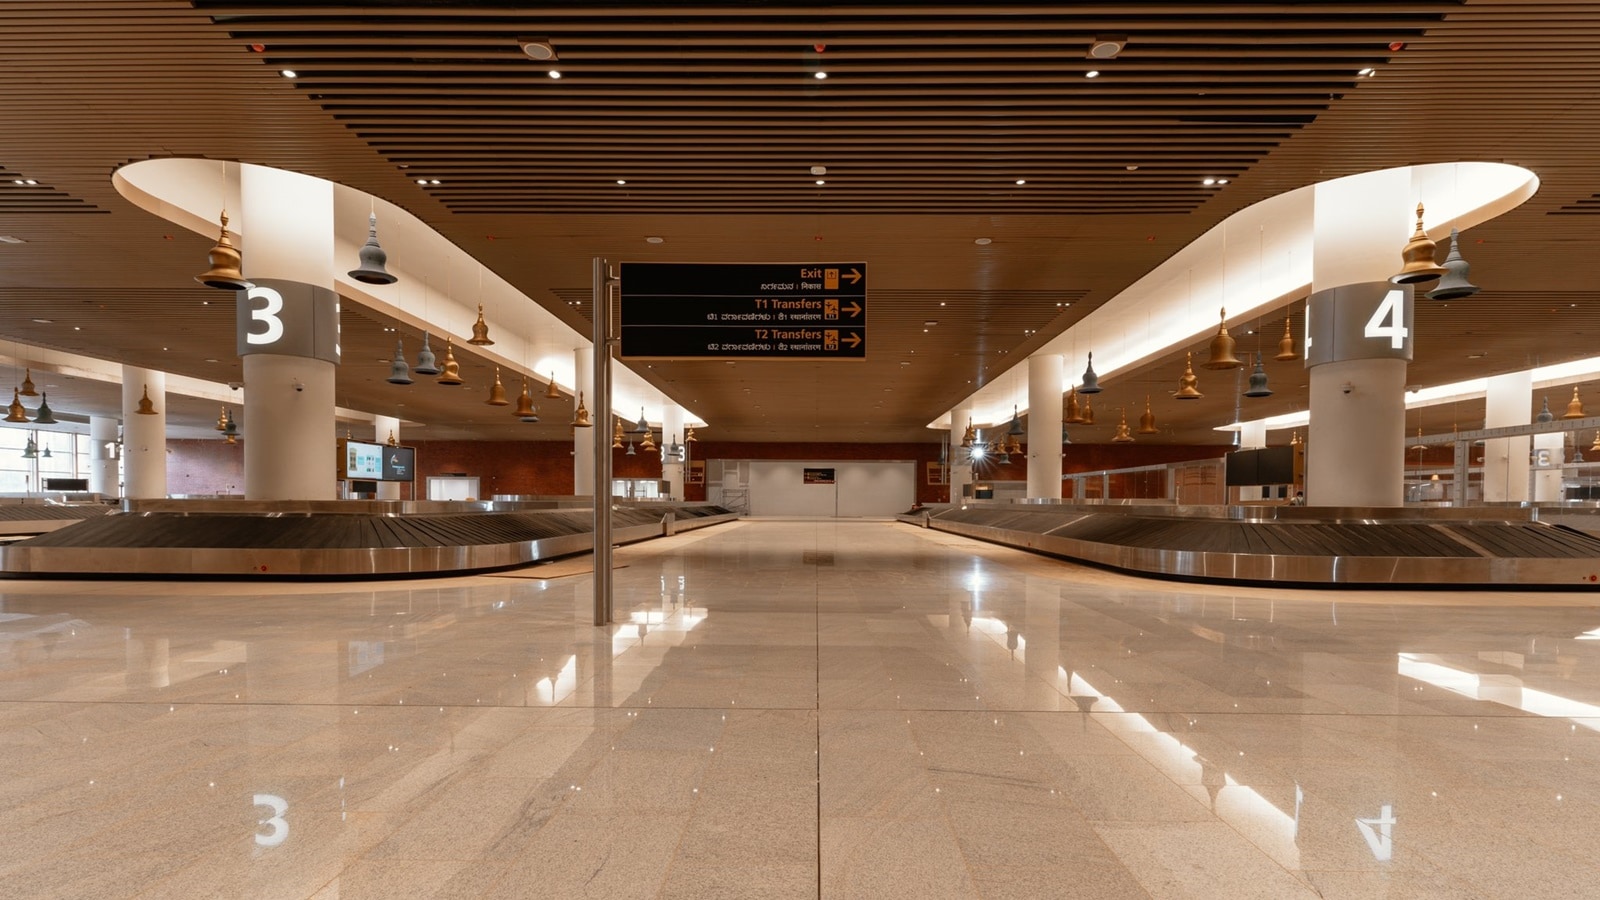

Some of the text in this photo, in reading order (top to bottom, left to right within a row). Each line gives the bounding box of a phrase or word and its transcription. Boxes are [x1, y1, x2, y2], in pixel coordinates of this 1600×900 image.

[800, 268, 822, 279] Exit
[800, 281, 822, 291] निकास
[754, 299, 822, 309] T1 Transfers
[247, 287, 284, 345] 3
[1364, 289, 1408, 350] 4
[754, 329, 822, 340] T2 Transfers
[104, 442, 116, 459] 1
[678, 445, 686, 462] 3
